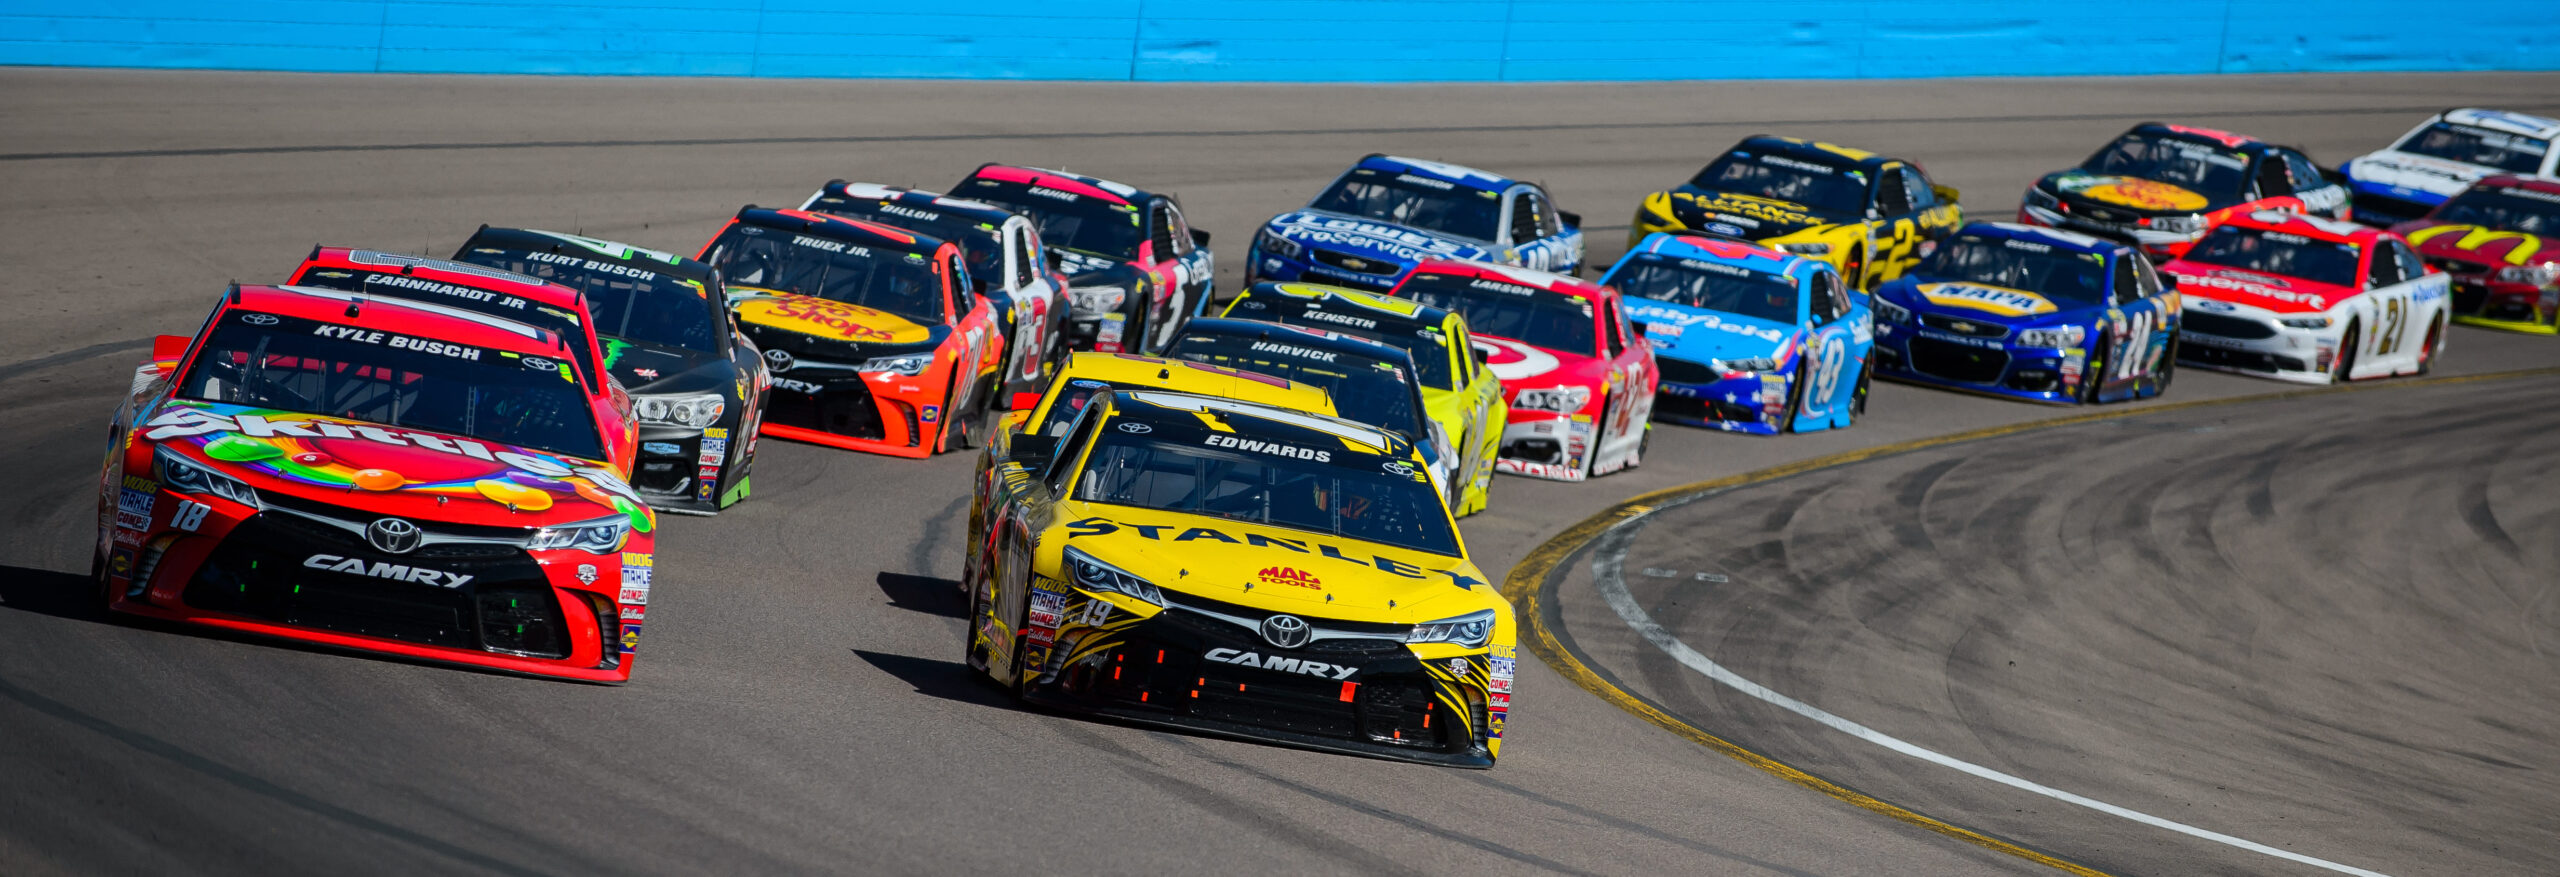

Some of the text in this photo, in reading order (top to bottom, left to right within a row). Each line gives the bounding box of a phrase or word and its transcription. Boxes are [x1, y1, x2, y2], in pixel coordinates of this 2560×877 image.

[1028, 186, 1079, 202] KAHNE
[880, 204, 939, 222] DILLON
[792, 235, 871, 258] TRUEX JR.
[526, 251, 657, 281] KURT BUSCH
[363, 274, 527, 310] EARNHARDT JR
[1470, 278, 1535, 297] LARSON
[1937, 283, 2036, 309] NAPA
[2168, 270, 2325, 311] otorcraft
[764, 303, 896, 340] Shops
[1303, 309, 1377, 330] KENSETH
[314, 324, 482, 362] KYLE BUSCH
[1250, 341, 1337, 363] HARVICK
[769, 376, 824, 394] MRY
[702, 428, 728, 439] MOOG
[146, 407, 642, 503] Skittles
[701, 440, 724, 452] MAHLE
[1204, 434, 1331, 464] EDWARDS
[121, 474, 159, 495] MOOG
[119, 490, 155, 513] MAHLE
[170, 500, 212, 532] 18
[621, 551, 654, 568] MOOG
[1065, 516, 1487, 593] STANLEY
[303, 554, 475, 588] CAMRY
[580, 571, 597, 581] 25
[1258, 566, 1321, 584] MAC
[1034, 576, 1069, 594] MOOG
[1258, 577, 1322, 590] TOOLS
[1032, 592, 1066, 611] MAHLE
[1030, 611, 1054, 625] COMP
[1080, 598, 1114, 627] 19
[1490, 645, 1516, 659] MOOG
[1203, 648, 1360, 681] CAMRY
[1452, 666, 1467, 674] 25
